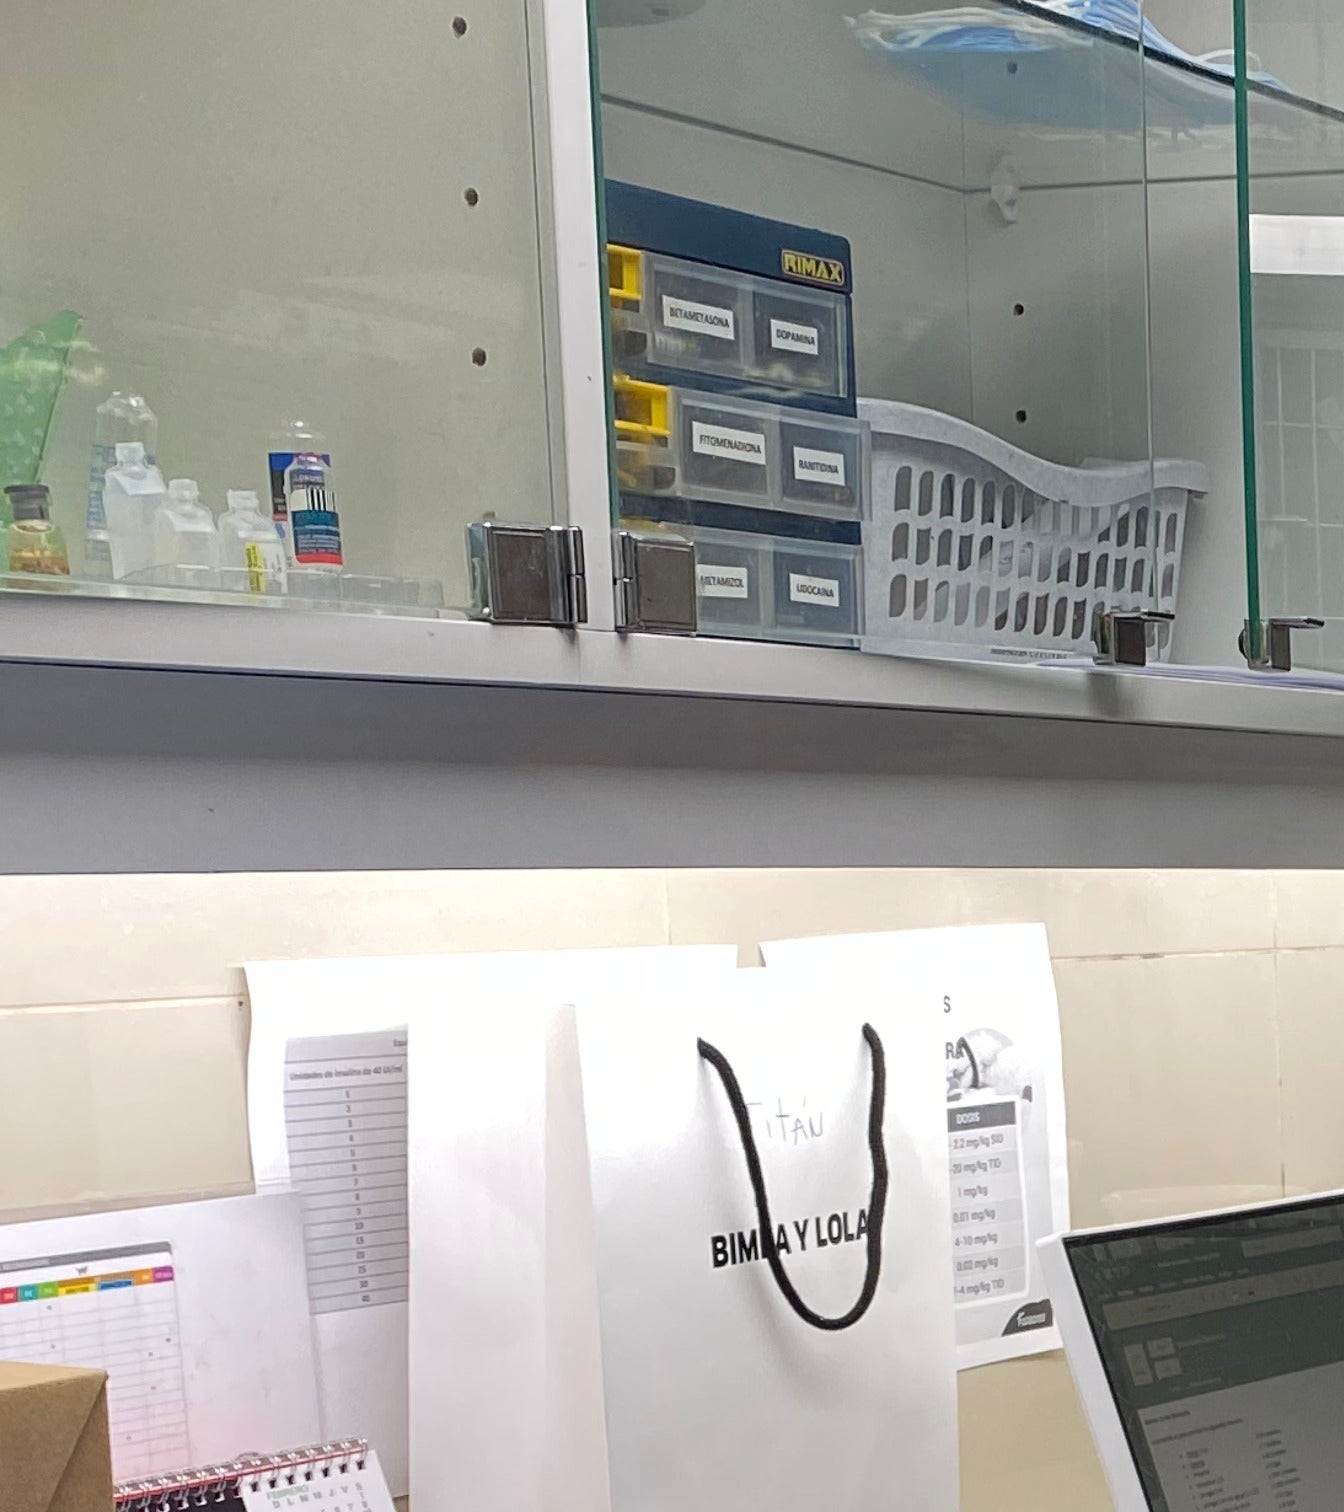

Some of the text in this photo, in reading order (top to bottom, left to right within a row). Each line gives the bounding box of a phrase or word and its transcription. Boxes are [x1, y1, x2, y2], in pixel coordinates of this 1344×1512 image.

[784, 253, 842, 282] RIMAX
[711, 1208, 869, 1268] BIMA Y LOLA
